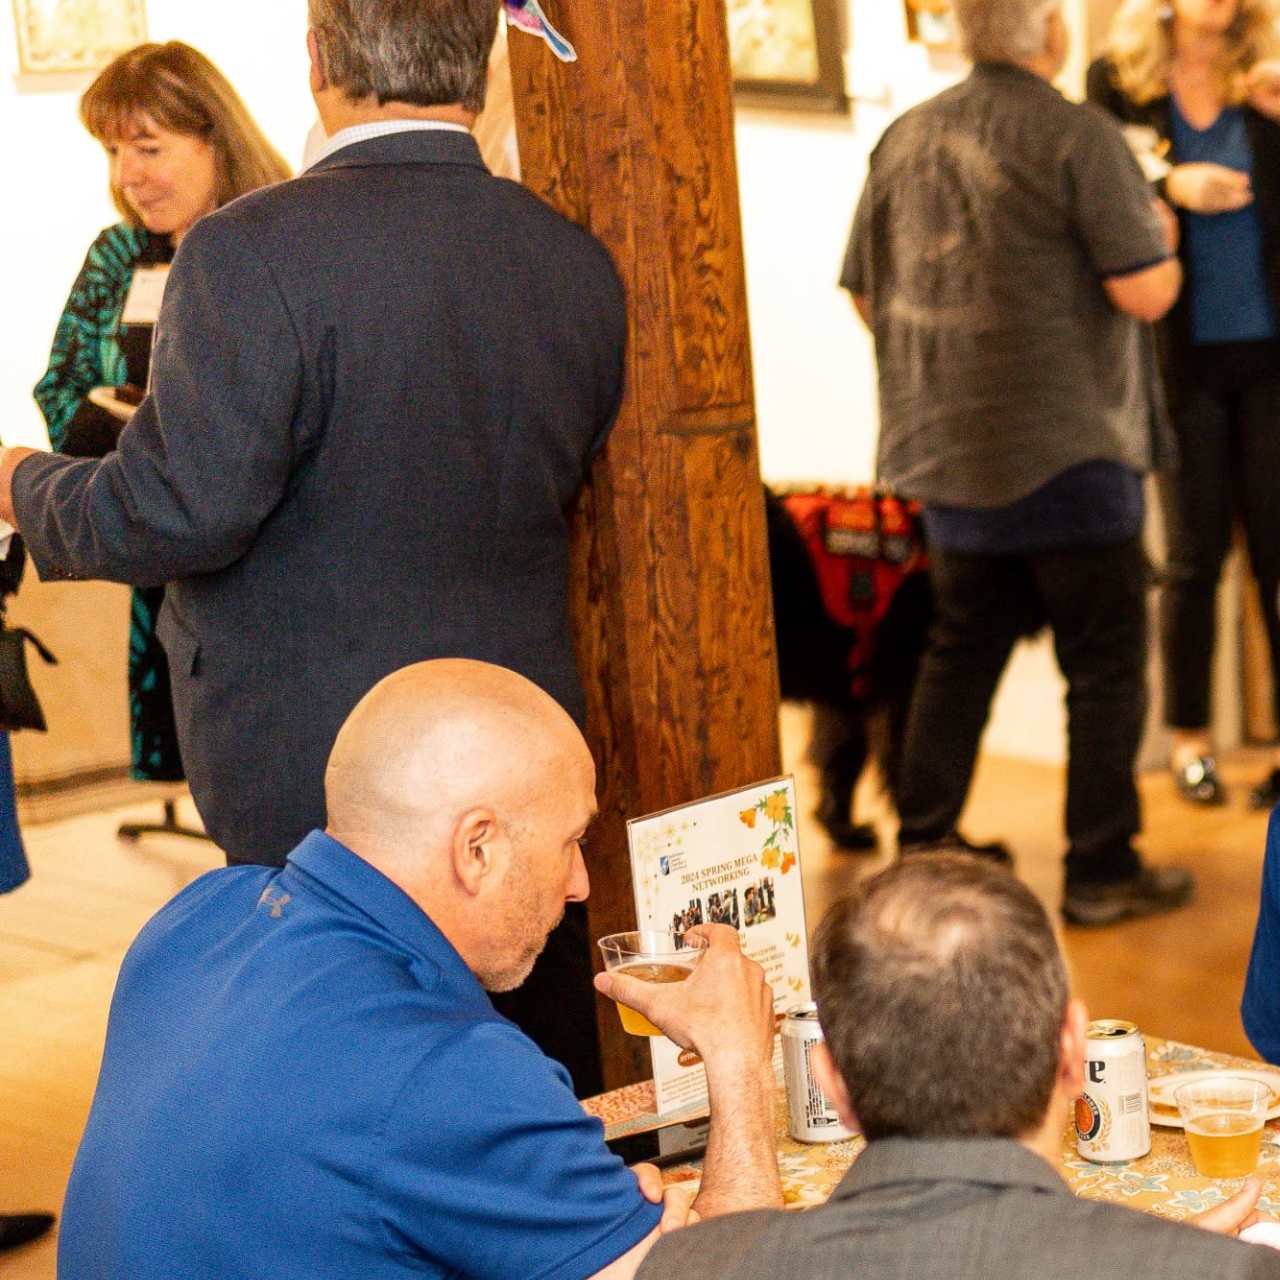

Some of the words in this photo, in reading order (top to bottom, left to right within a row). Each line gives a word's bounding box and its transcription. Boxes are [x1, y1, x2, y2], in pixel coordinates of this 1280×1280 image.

[681, 871, 700, 885] 2024
[701, 861, 733, 879] SPRING
[734, 853, 759, 869] MEGA
[692, 868, 751, 892] NETWORKING
